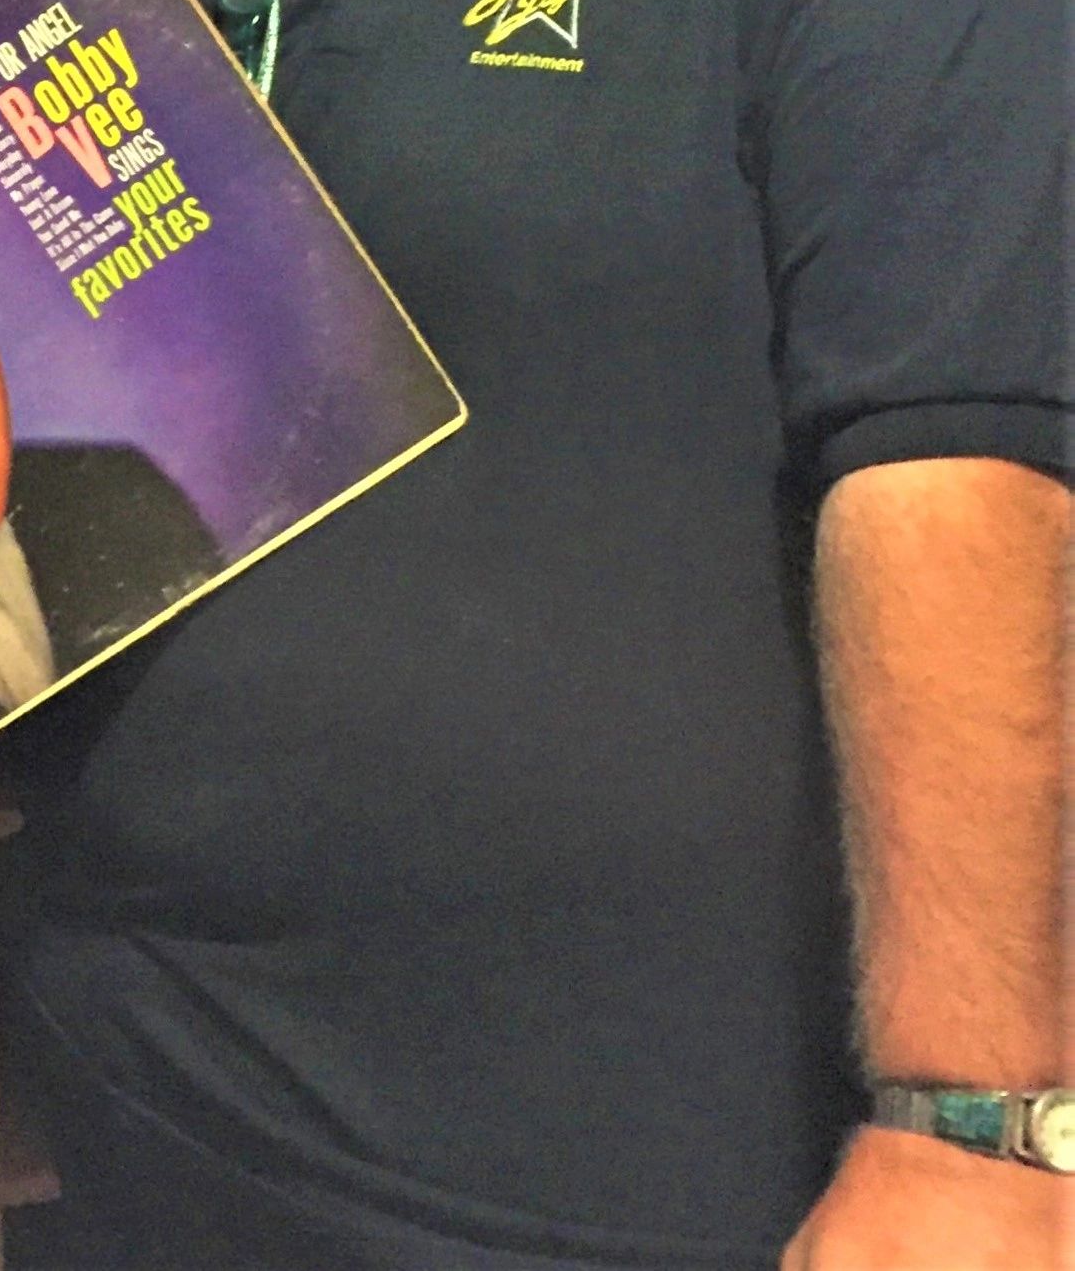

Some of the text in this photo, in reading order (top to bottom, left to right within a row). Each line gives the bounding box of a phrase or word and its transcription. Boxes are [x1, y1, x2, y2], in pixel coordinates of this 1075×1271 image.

[18, 1, 83, 62] ANGEL
[469, 50, 584, 73] Entertainment
[54, 88, 144, 189] Vee
[107, 128, 165, 182] SINGS
[112, 158, 185, 237] your
[70, 197, 211, 319] favorites
